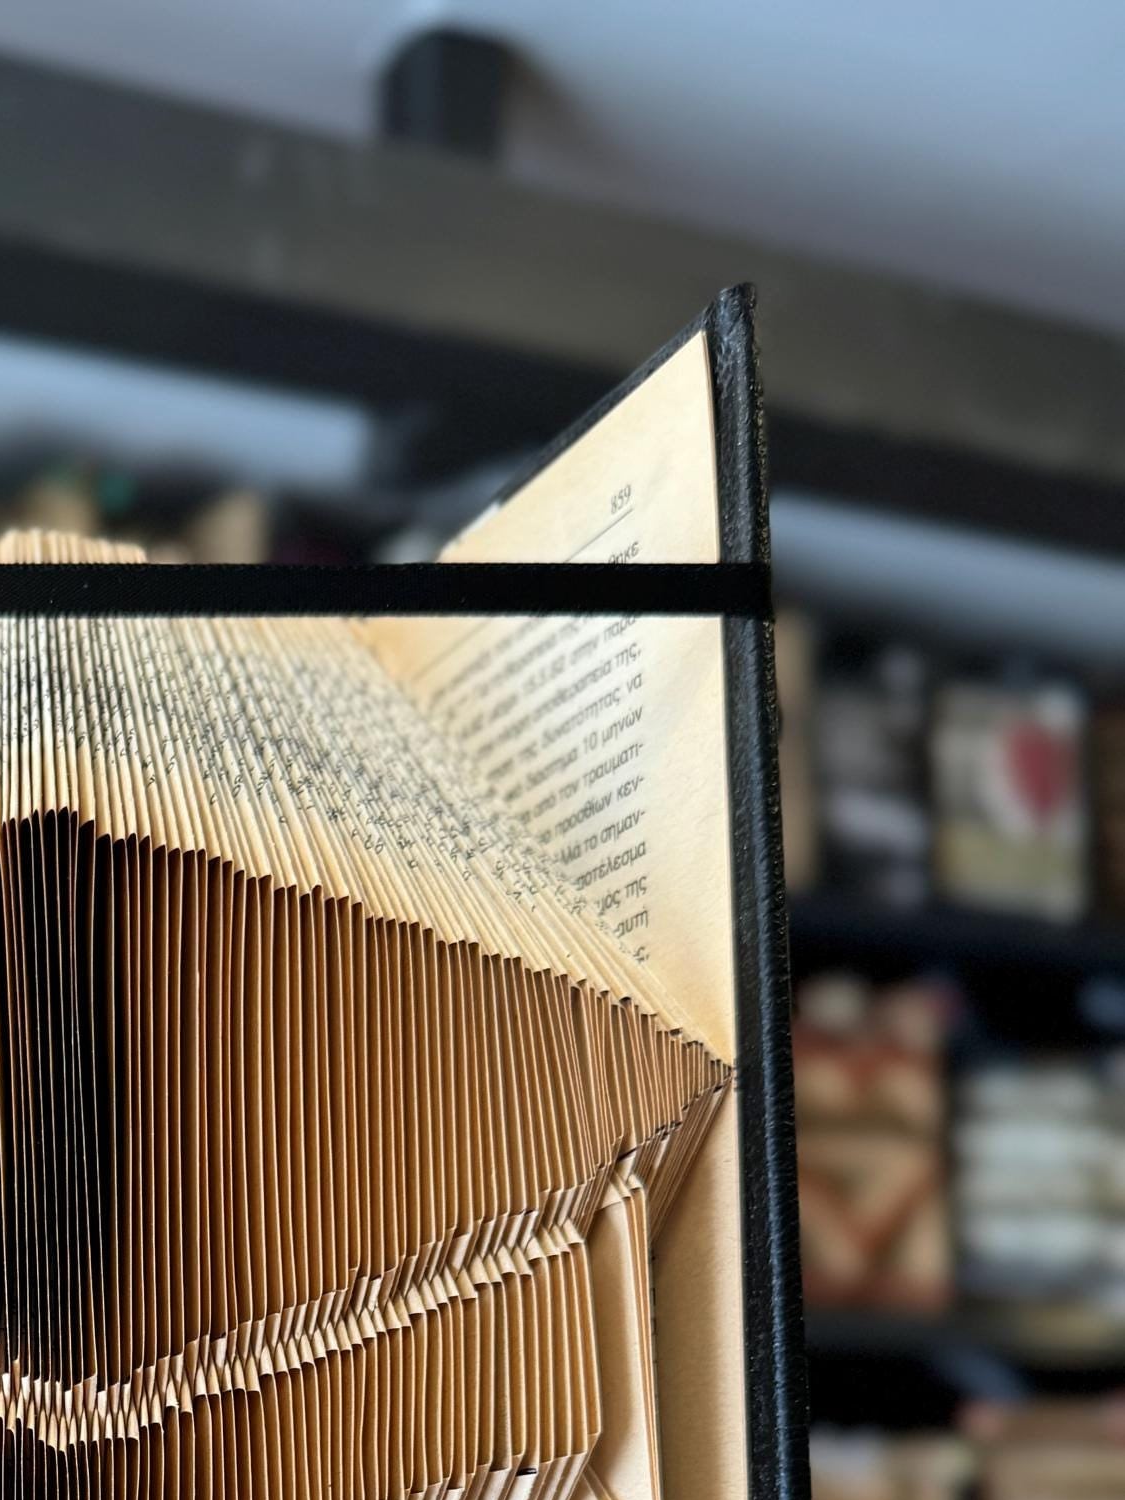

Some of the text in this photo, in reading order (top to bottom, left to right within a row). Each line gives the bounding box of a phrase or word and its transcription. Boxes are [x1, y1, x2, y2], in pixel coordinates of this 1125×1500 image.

[609, 484, 632, 515] 859
[627, 673, 643, 694] να
[583, 731, 598, 756] 10
[602, 703, 644, 749] μηνών
[616, 774, 644, 802] κεν-
[583, 835, 598, 854] το
[600, 810, 646, 845] σημαν-
[624, 875, 648, 899] της
